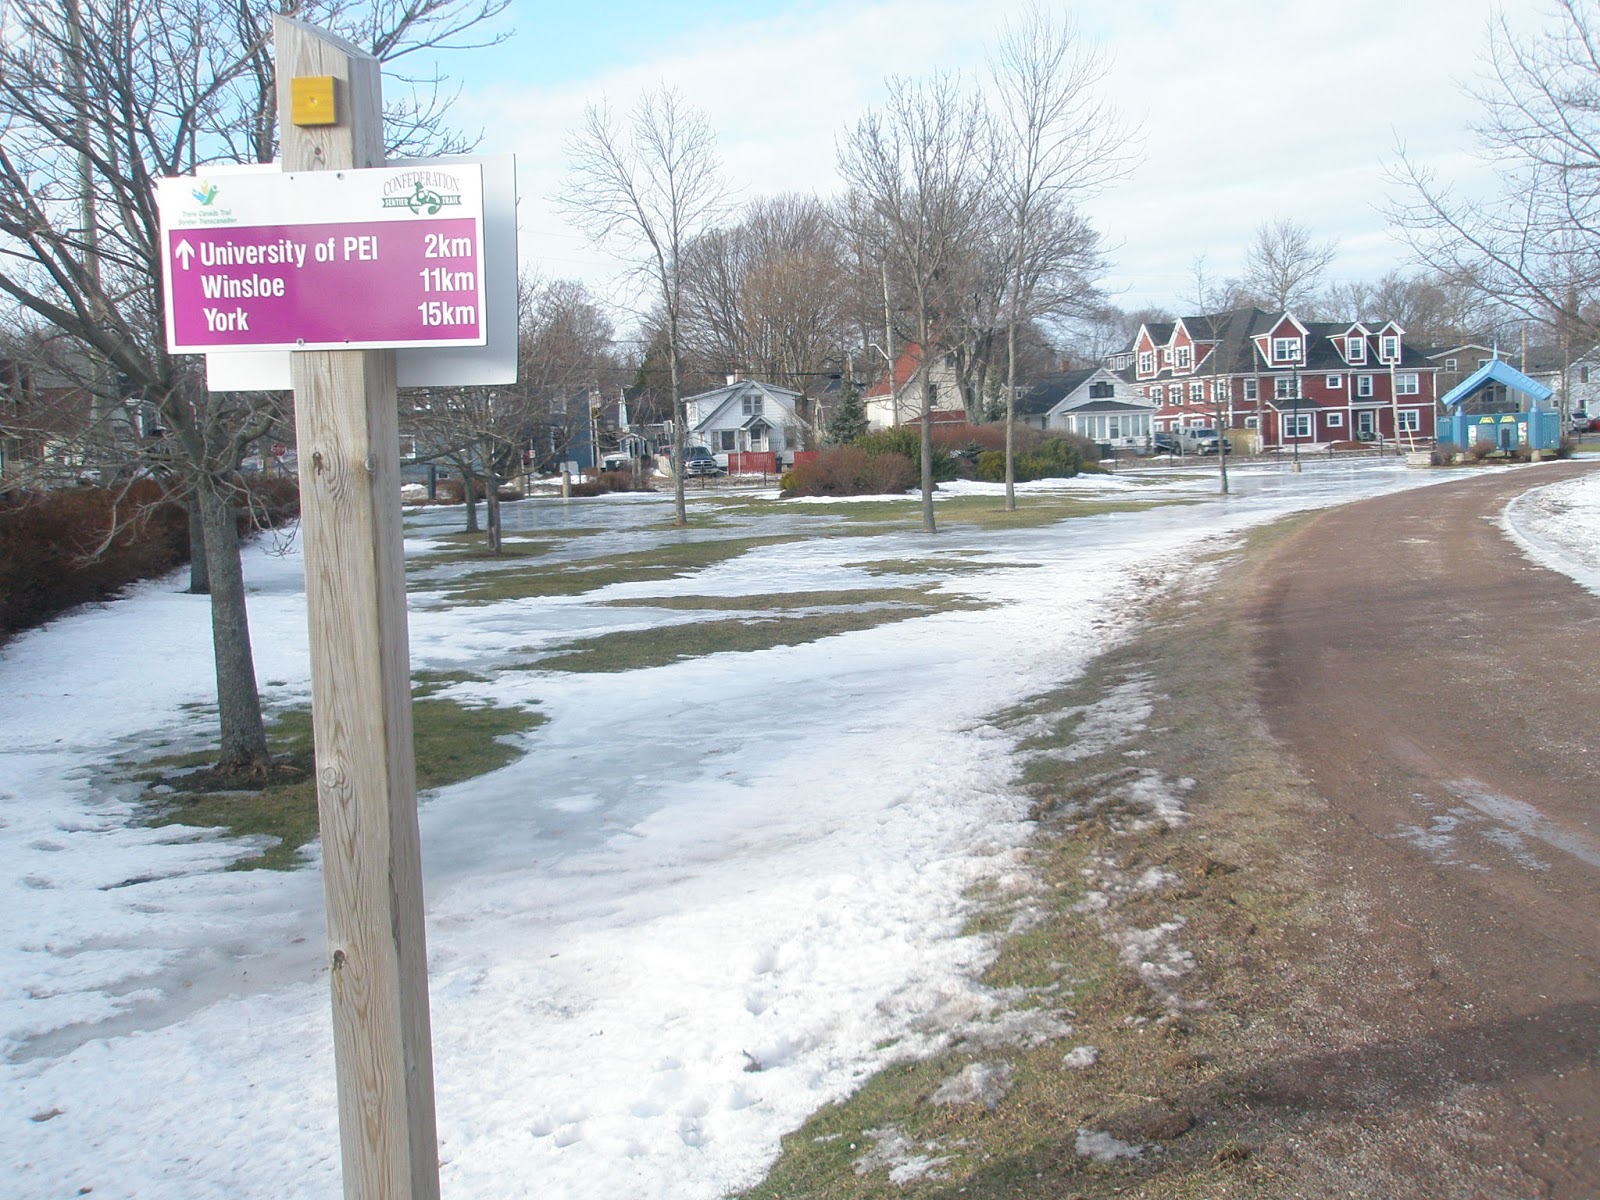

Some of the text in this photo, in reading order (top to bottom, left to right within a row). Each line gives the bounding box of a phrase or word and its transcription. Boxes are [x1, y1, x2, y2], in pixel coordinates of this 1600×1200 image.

[385, 195, 459, 207] SENTIER TRAIL
[200, 235, 379, 269] University of PEI
[424, 233, 473, 259] 2km
[201, 273, 286, 299] Winsloe
[419, 267, 475, 292] 11km
[203, 307, 249, 332] York
[417, 301, 476, 326] 15km
